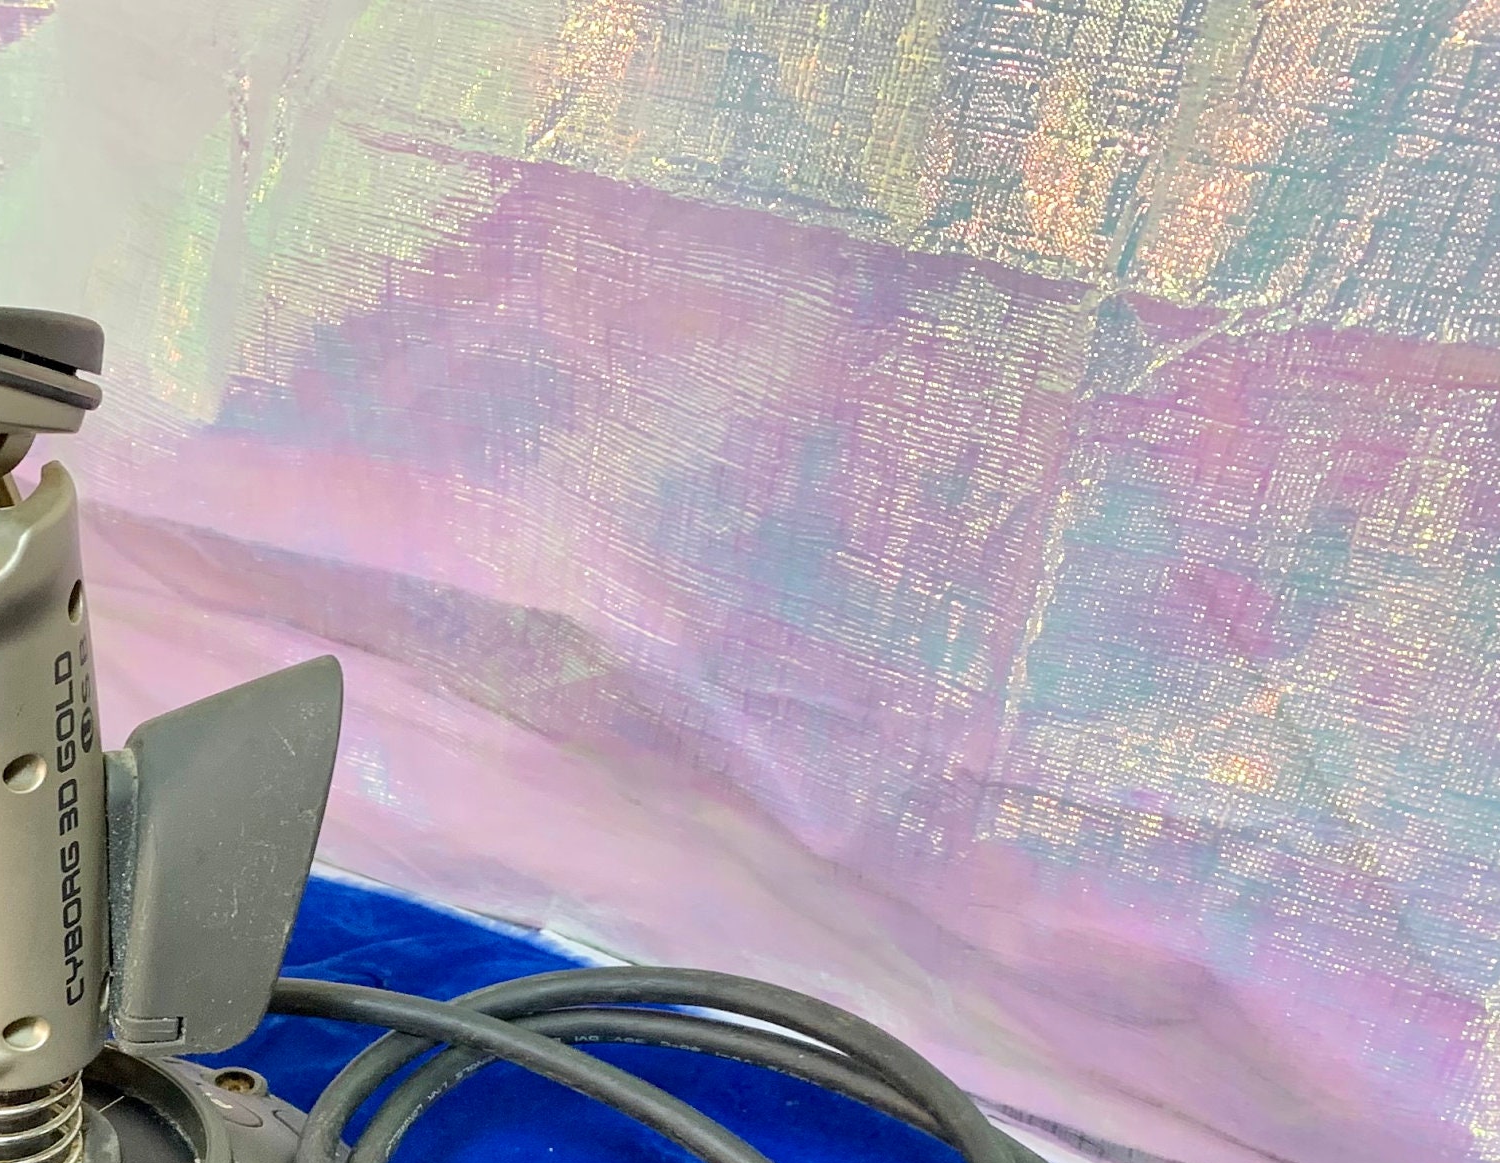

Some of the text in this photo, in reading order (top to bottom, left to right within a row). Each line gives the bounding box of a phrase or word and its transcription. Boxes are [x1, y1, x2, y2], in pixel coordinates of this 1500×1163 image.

[54, 650, 88, 1006] CYBORG 3D GOLD
